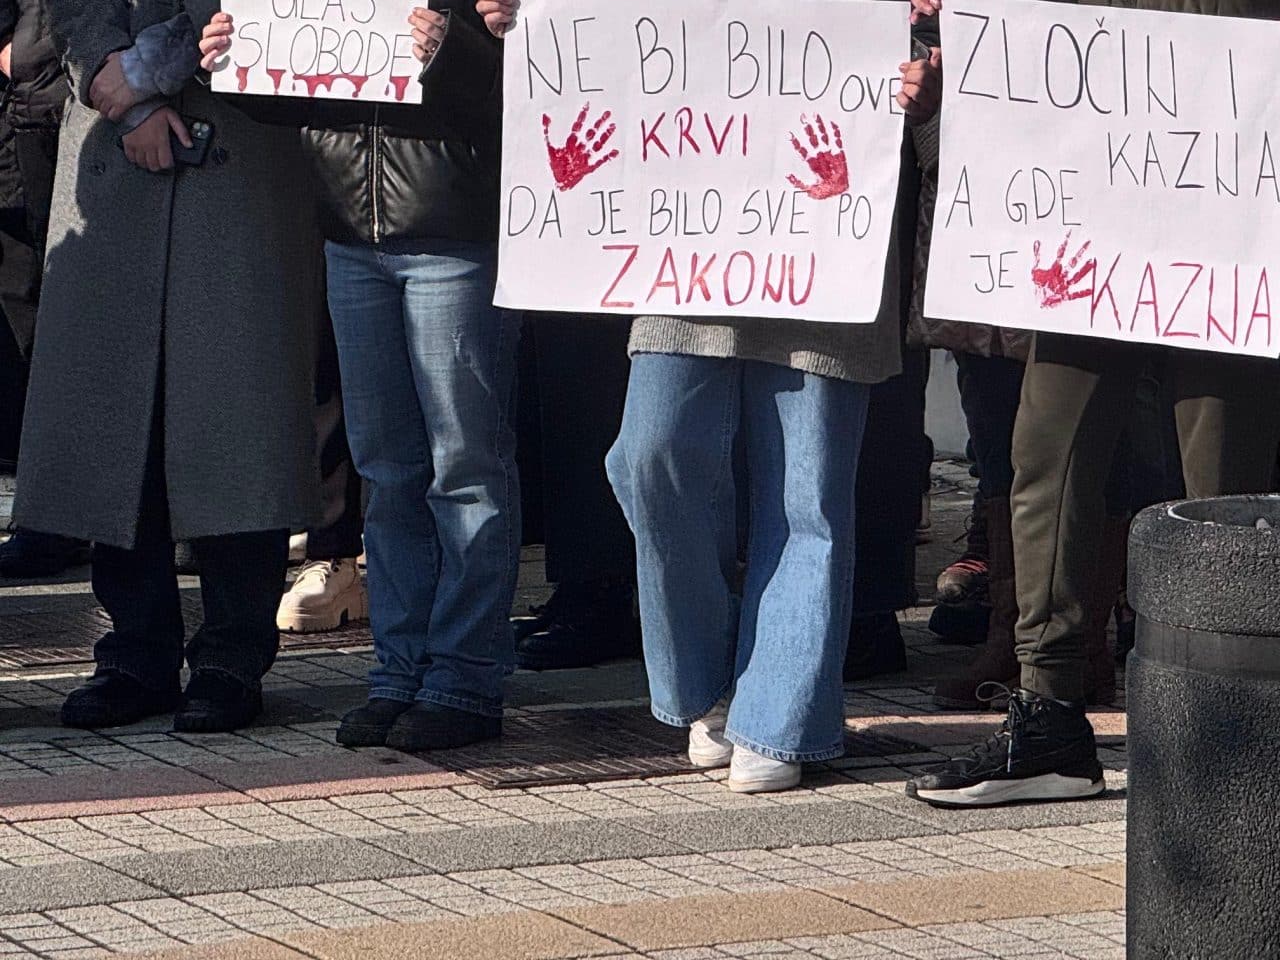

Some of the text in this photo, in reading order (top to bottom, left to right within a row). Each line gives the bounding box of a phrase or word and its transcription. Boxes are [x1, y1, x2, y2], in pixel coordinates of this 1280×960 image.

[234, 22, 412, 78] SLOBODE
[525, 16, 905, 115] NE BI BILO OVE
[953, 11, 1238, 119] ZLOČIN I
[640, 106, 749, 162] KRVI
[1107, 130, 1280, 202] KAZNA
[507, 185, 872, 240] DA JE BILO SVE PO
[945, 165, 1082, 229] A GDE
[600, 244, 816, 307] ZAKONU
[969, 250, 1272, 347] JE KAZNA
